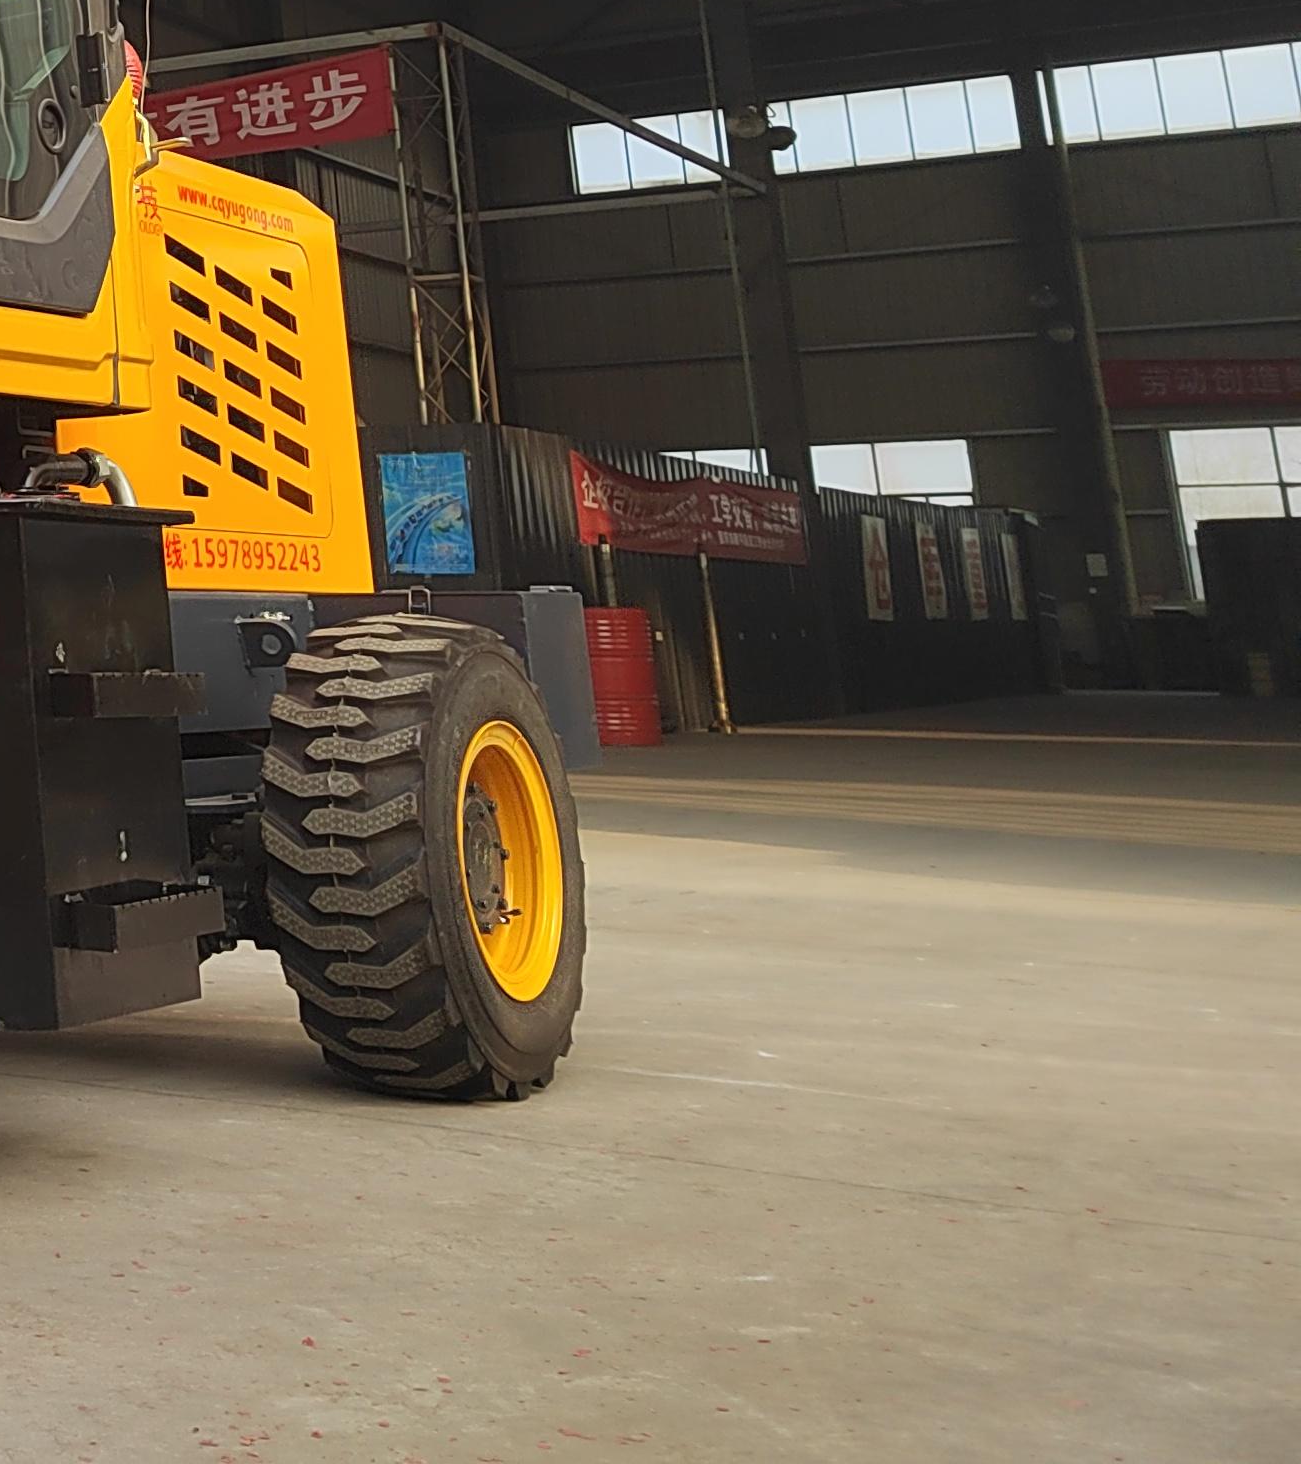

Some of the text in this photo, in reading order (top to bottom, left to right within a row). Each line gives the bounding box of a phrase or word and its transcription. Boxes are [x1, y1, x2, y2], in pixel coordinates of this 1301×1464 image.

[145, 68, 368, 147] 有进步
[176, 185, 294, 233] www.cqyugong.com
